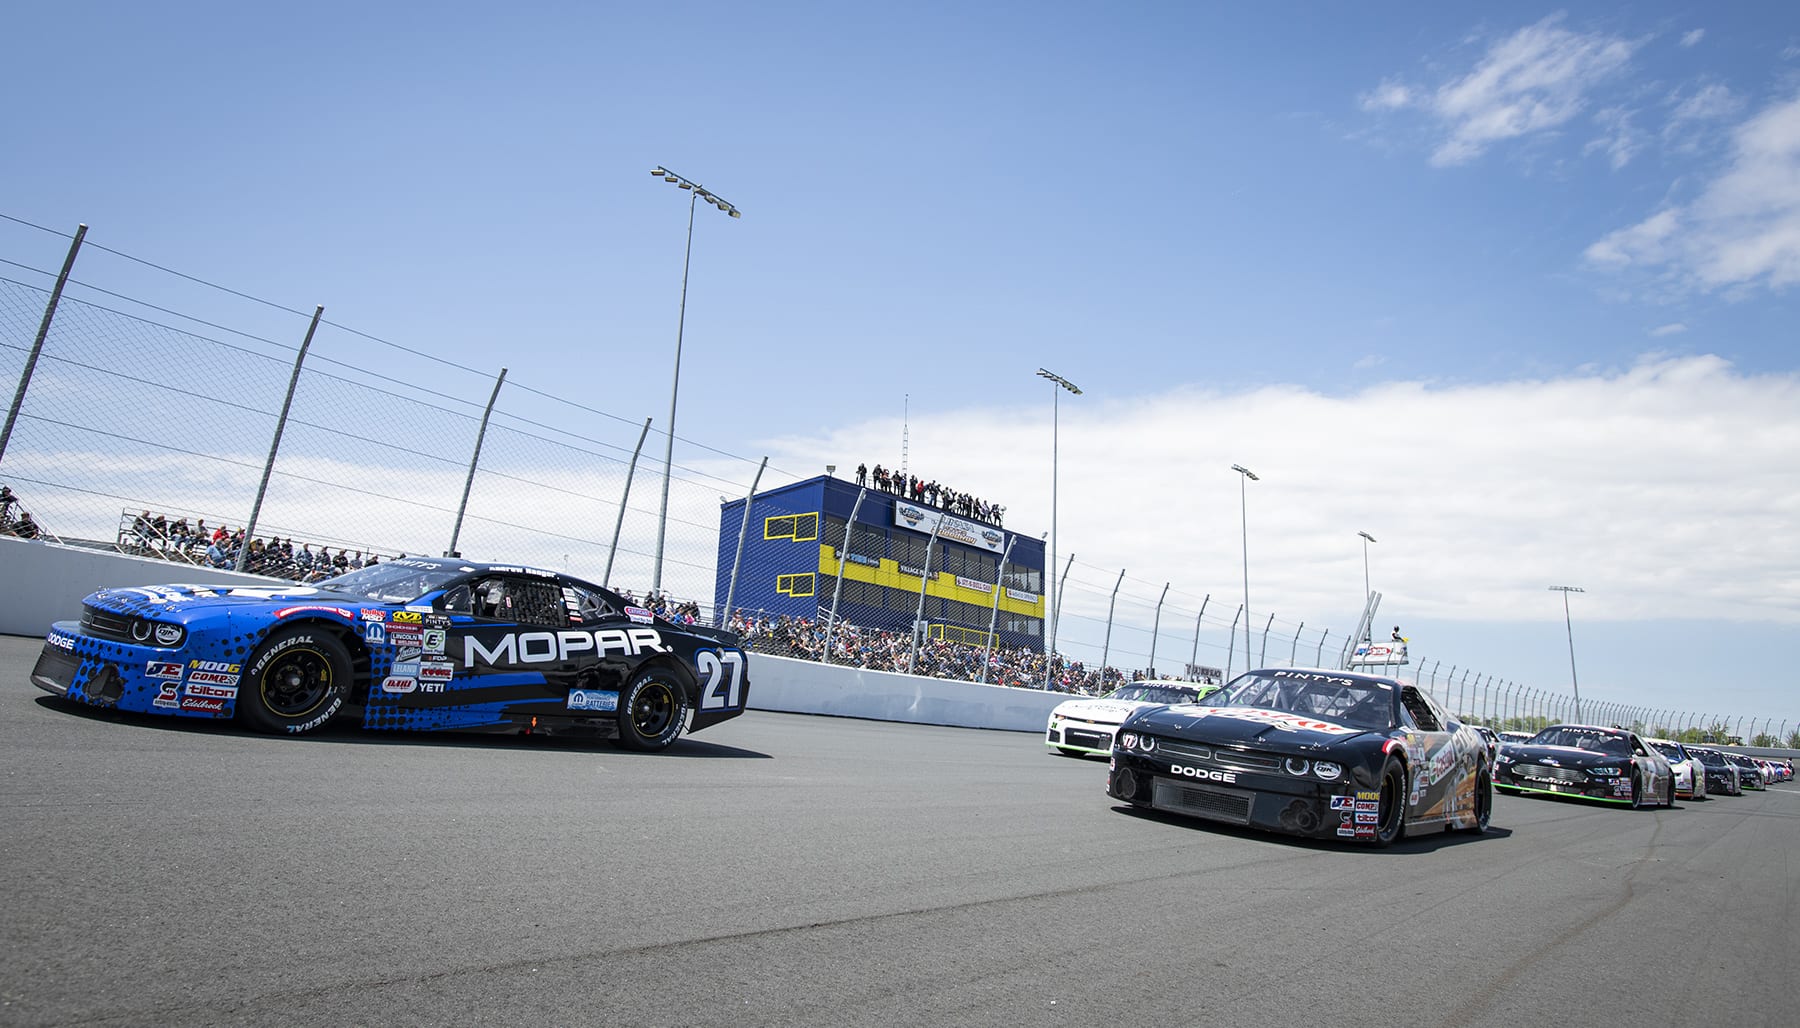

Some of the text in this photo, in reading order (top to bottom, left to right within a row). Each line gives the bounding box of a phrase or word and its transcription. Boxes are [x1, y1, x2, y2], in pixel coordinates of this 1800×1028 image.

[48, 632, 75, 650] DODGE
[392, 633, 418, 641] LINCOLN
[256, 635, 313, 670] GENERAL
[188, 659, 241, 673] MOOG
[697, 649, 743, 710] 27
[1274, 671, 1354, 687] PINTY'S
[189, 684, 235, 698] tilton
[419, 683, 445, 693] YETI
[627, 675, 653, 715] GENERAL
[182, 698, 224, 711] Edelbrock
[585, 699, 616, 708] BATTERIES
[286, 697, 342, 734] GENERAL
[1170, 764, 1237, 784] DODGE
